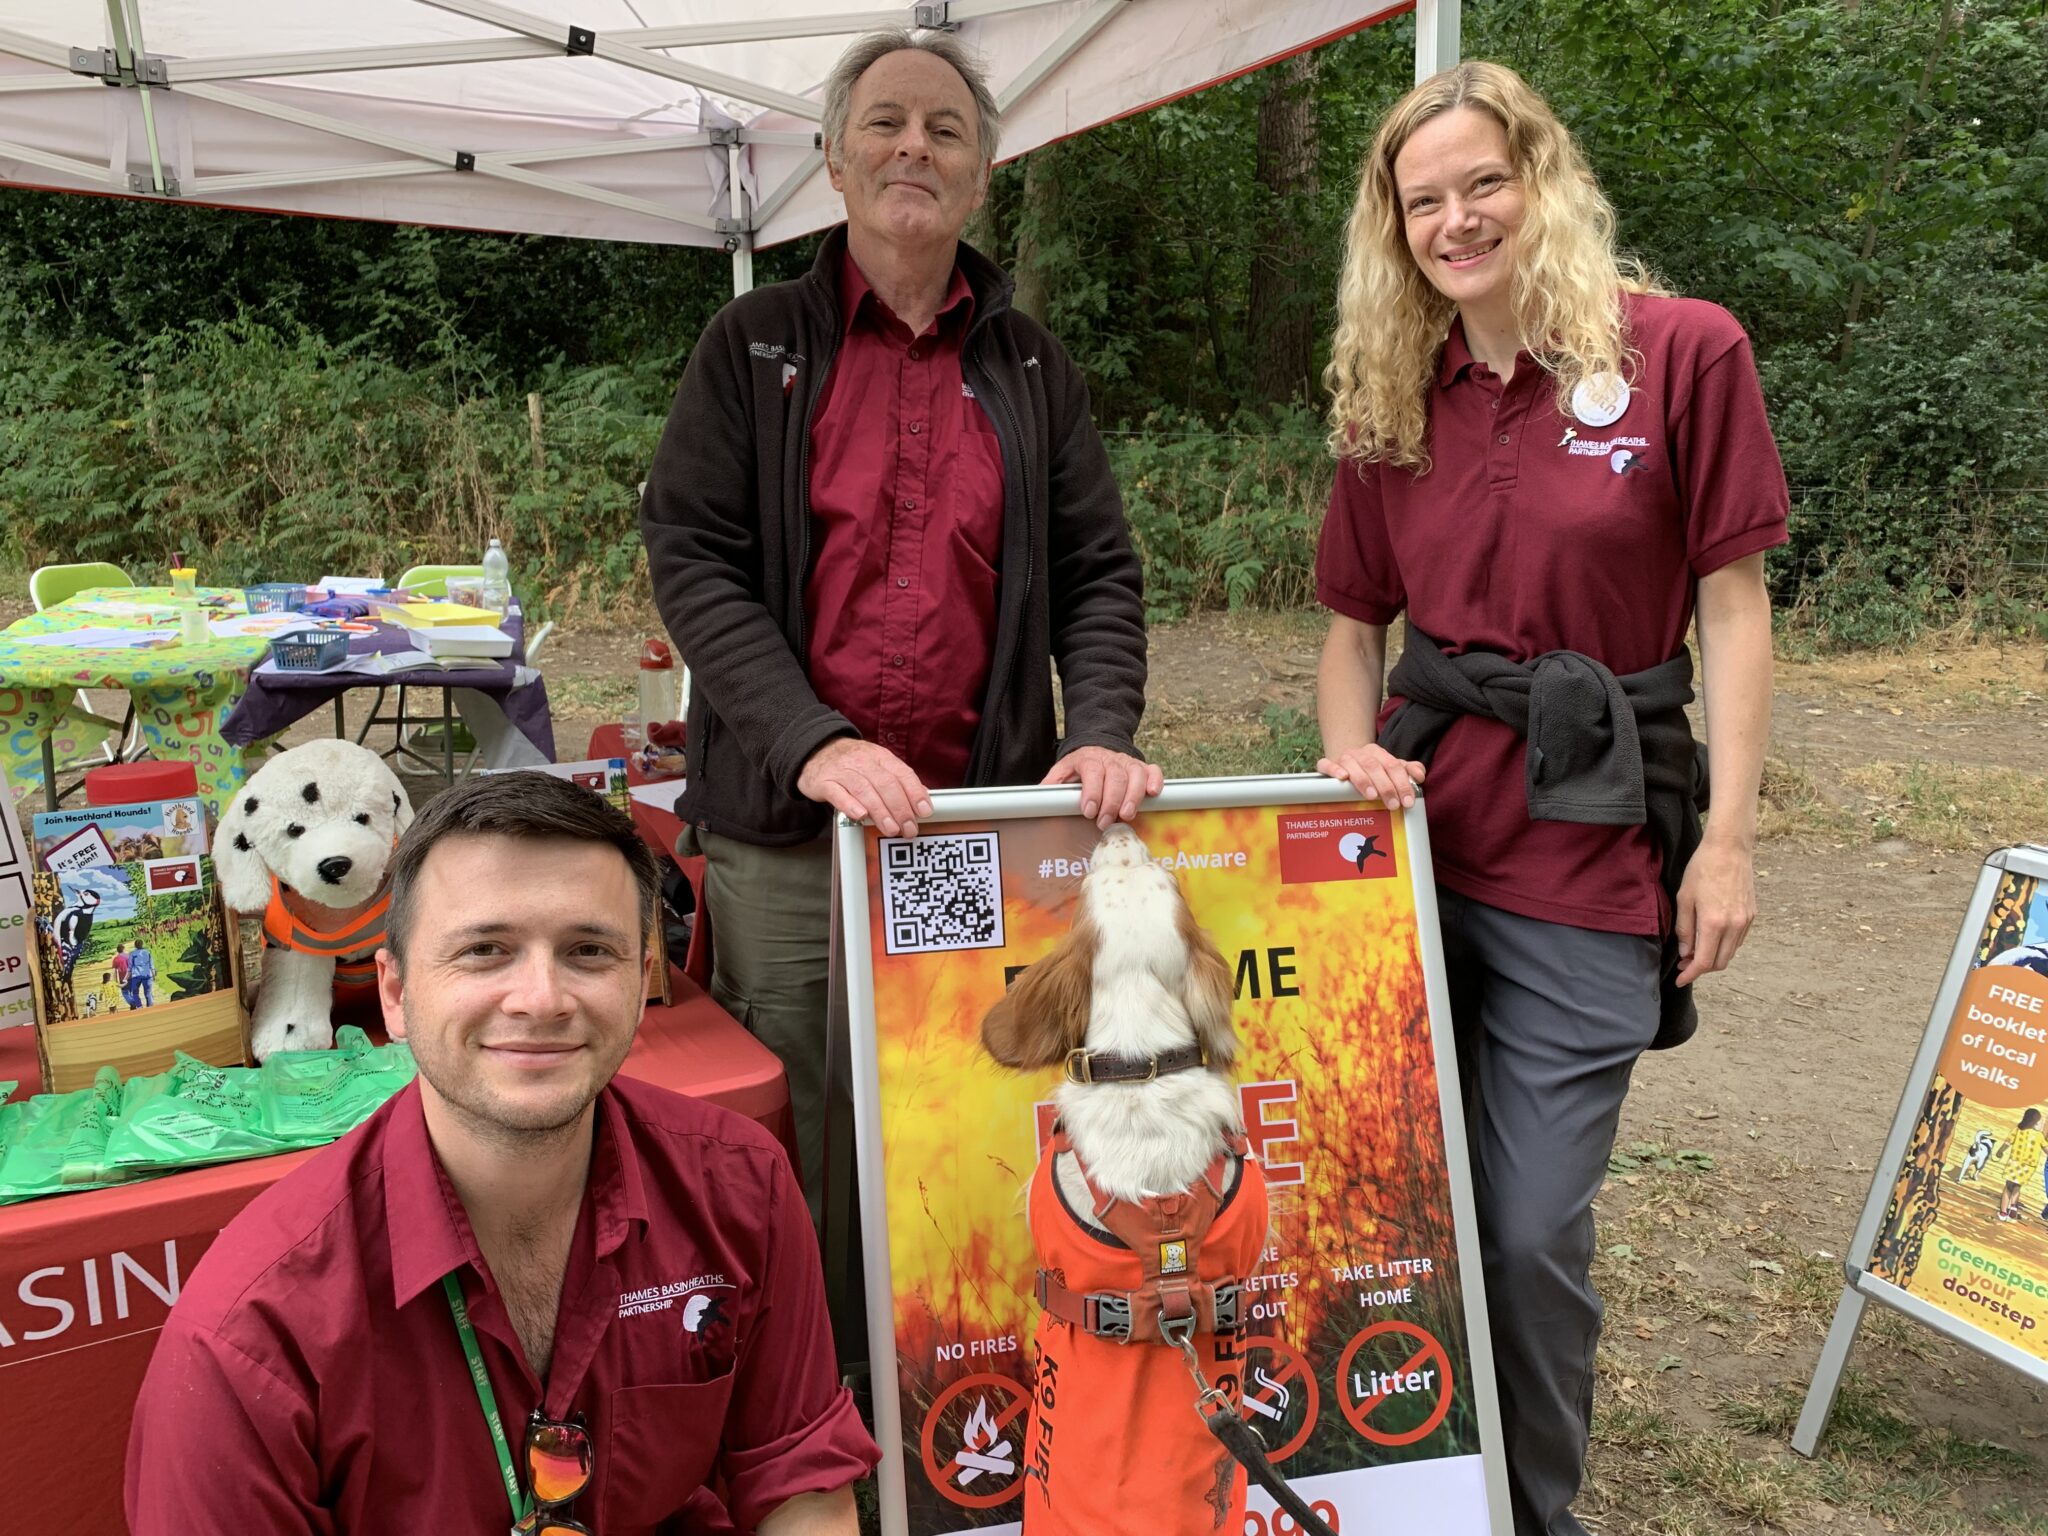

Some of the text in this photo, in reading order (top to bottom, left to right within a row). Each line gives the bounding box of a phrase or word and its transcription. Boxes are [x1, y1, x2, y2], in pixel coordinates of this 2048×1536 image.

[45, 807, 151, 825] Join Heathland Hounds!
[1285, 817, 1374, 830] THAMES BASIN HEATHS
[1286, 831, 1329, 840] PARTNERSHIP
[57, 843, 97, 870] It's FREE
[1988, 984, 2044, 1014] FREE
[1967, 1004, 2047, 1044] booklet
[1961, 1034, 2037, 1068] of local
[1960, 1059, 2020, 1090] walks
[1259, 1247, 1280, 1263] RE
[1938, 1238, 2048, 1298] Greenspac
[1245, 1272, 1299, 1292] RETTES
[1331, 1258, 1434, 1283] TAKE LITTER
[1937, 1258, 2016, 1301] on your
[620, 1275, 724, 1305] THAMES BASIN HEATHS
[1360, 1288, 1413, 1308] HOME
[1943, 1277, 2036, 1330] doorstep
[452, 1301, 470, 1331] STAFF
[618, 1300, 673, 1319] PARTNERSHIP
[1252, 1301, 1288, 1320] OUT
[936, 1335, 1017, 1362] NO FIRES
[471, 1356, 488, 1387] STAFF
[1041, 1354, 1058, 1410] K9
[1354, 1369, 1435, 1398] Litter
[489, 1412, 505, 1441] STAFF
[505, 1465, 520, 1496] STAFF
